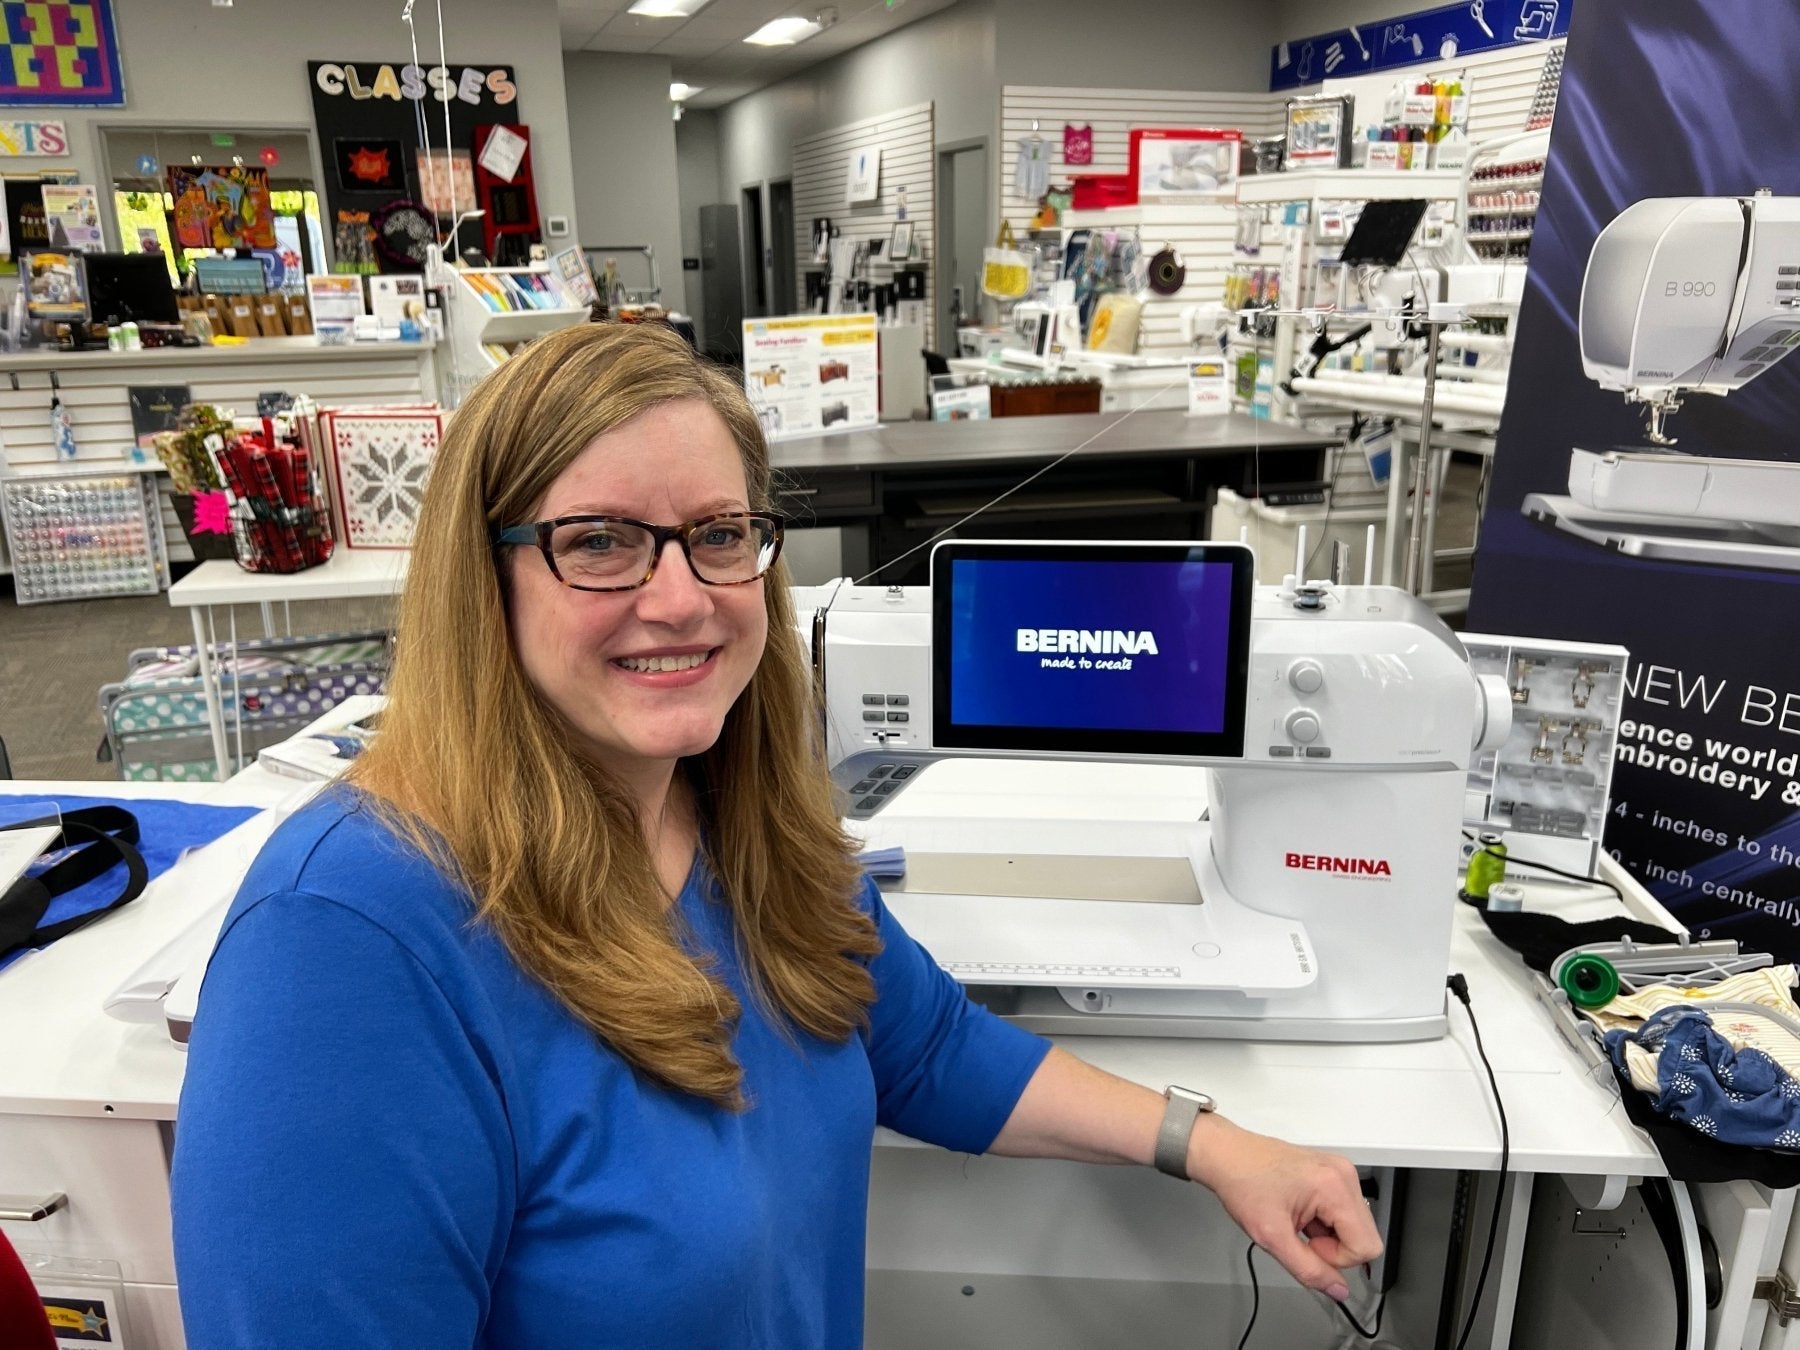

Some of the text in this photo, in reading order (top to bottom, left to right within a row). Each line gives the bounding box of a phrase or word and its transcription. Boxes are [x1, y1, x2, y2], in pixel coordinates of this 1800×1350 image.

[317, 63, 517, 105] CLASSES
[1664, 281, 1716, 297] B 990
[1637, 370, 1674, 378] BERNINA
[1017, 628, 1159, 655] BERNINA
[1041, 656, 1133, 670] made to create
[1624, 663, 1800, 735] NEW BE
[1619, 719, 1694, 751] ence
[1615, 742, 1800, 806] mbroidery &
[1652, 810, 1729, 847] inches
[1737, 834, 1761, 855] to
[1285, 853, 1391, 875] BERNINA
[1645, 859, 1694, 888] inch
